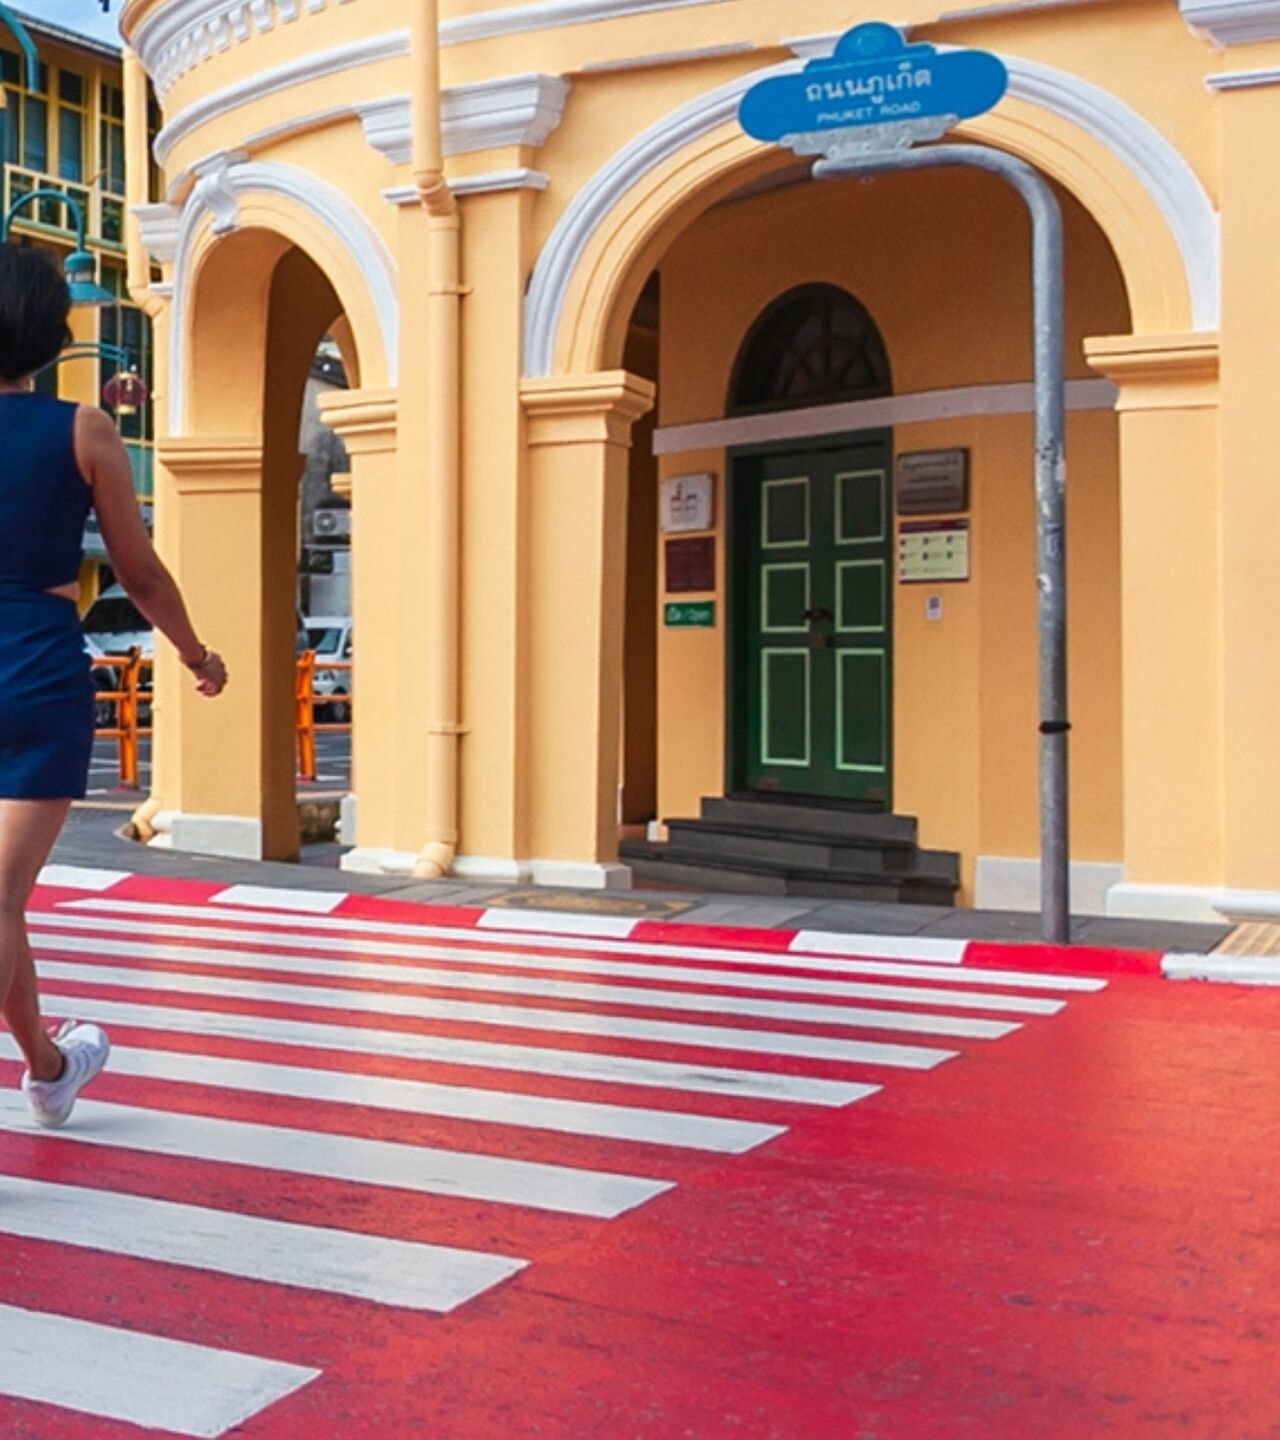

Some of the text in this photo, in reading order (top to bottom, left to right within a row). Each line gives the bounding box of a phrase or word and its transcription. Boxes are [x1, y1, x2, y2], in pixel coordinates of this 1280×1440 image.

[806, 61, 931, 105] ถนนภูเก็ต
[817, 100, 921, 123] PHUKET ROAD
